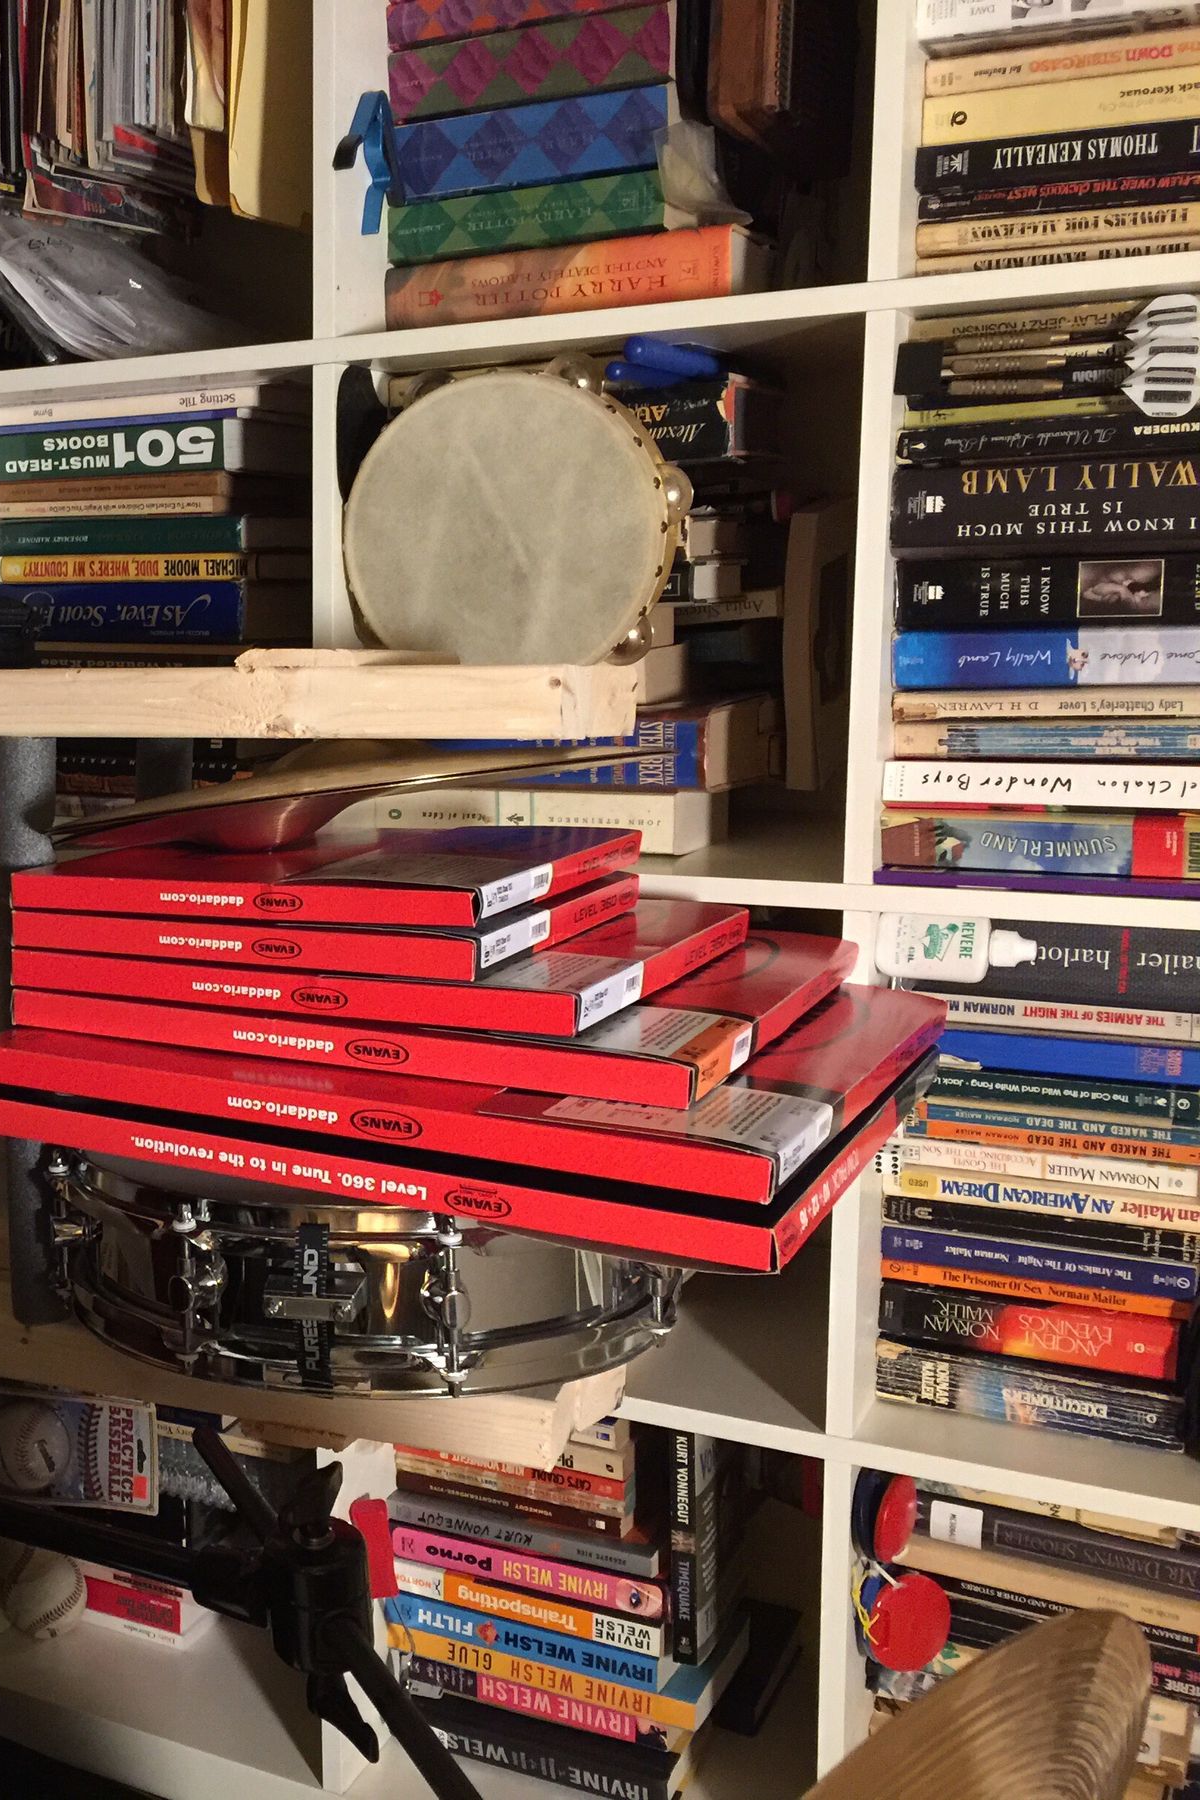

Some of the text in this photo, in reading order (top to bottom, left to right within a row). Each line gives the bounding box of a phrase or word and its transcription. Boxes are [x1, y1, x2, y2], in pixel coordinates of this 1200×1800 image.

[992, 132, 1158, 170] THOMAS KENEALLY
[466, 215, 526, 232] POTTER
[530, 206, 592, 222] HARRY
[970, 207, 1189, 243] FLOWERS FOR ALGERNON
[471, 256, 668, 288] AND THE DEATHLY HALLOWS
[472, 273, 666, 306] HARRY POTTER
[32, 392, 236, 418] Setting Tile Byrne
[5, 426, 216, 472] 501 MUST-READ
[42, 434, 109, 452] BOOKS
[960, 460, 1198, 495] WALLY LAMB
[1027, 501, 1122, 516] IS TRUE
[956, 516, 1196, 536] I KNOW THIS MUCH
[22, 558, 248, 578] MICHAEL MOORE DUDE, WHERE'S MY COUNTRY?
[979, 566, 990, 618] IS TRUE
[998, 571, 1010, 610] MUCH
[1019, 574, 1030, 606] THIS
[58, 593, 211, 628] As Ever, Scott
[920, 771, 1172, 795] Chabon Wonder Boys
[547, 814, 661, 827] JOHN STEINBECK
[979, 830, 1118, 858] SUMMERLAND
[159, 892, 296, 908] EVANS daddario.com
[574, 894, 617, 924] LEVEL 360
[158, 936, 296, 954] EVANS daddario.com
[958, 922, 976, 960] REVERE
[191, 982, 341, 1006] EVANS daddario.com
[962, 1000, 1165, 1026] THE ARMIES OF THE NIGHT NORMAN
[232, 1030, 400, 1060] EVANS daddario.com
[942, 1077, 1128, 1104] The Call of the Wild and White Fang Jack
[226, 1096, 413, 1134] EVANS daddario.com
[954, 1110, 1172, 1140] THE NAKED AND THE DEAD NORMAN MAILER
[954, 1128, 1171, 1158] THE NAKED AND THE DEAD NORMAN MAILER
[130, 1136, 502, 1214] EVANS Level 360. Tune in to the revolution.
[908, 1178, 929, 1188] USED
[1048, 1163, 1160, 1190] NORMAN MAILER
[940, 1179, 1175, 1222] Mailer AN AMERICAN DREAM
[944, 1244, 1132, 1281] The Armies Of The Night Norman Mailer
[932, 1300, 994, 1323] MAILER
[924, 1314, 999, 1340] NORMAN
[1018, 1313, 1112, 1344] EVENINGS
[1022, 1330, 1106, 1357] ANCIENT
[108, 1405, 122, 1501] BASEBALL
[122, 1408, 134, 1503] PRACTICE
[676, 1435, 689, 1525] KURT VONNEGUT
[424, 1544, 608, 1601] IRVINE WELSH Porno
[678, 1560, 690, 1622] TIMEQUAKE
[456, 1584, 578, 1632] Trainspotting
[594, 1618, 650, 1640] WELSH
[594, 1628, 650, 1650] IRVINE
[417, 1608, 653, 1684] IRVINE WELSH FILTH
[447, 1642, 651, 1714] IRVINE WELSH GLUE
[480, 1677, 630, 1736] IRVINE WELSH
